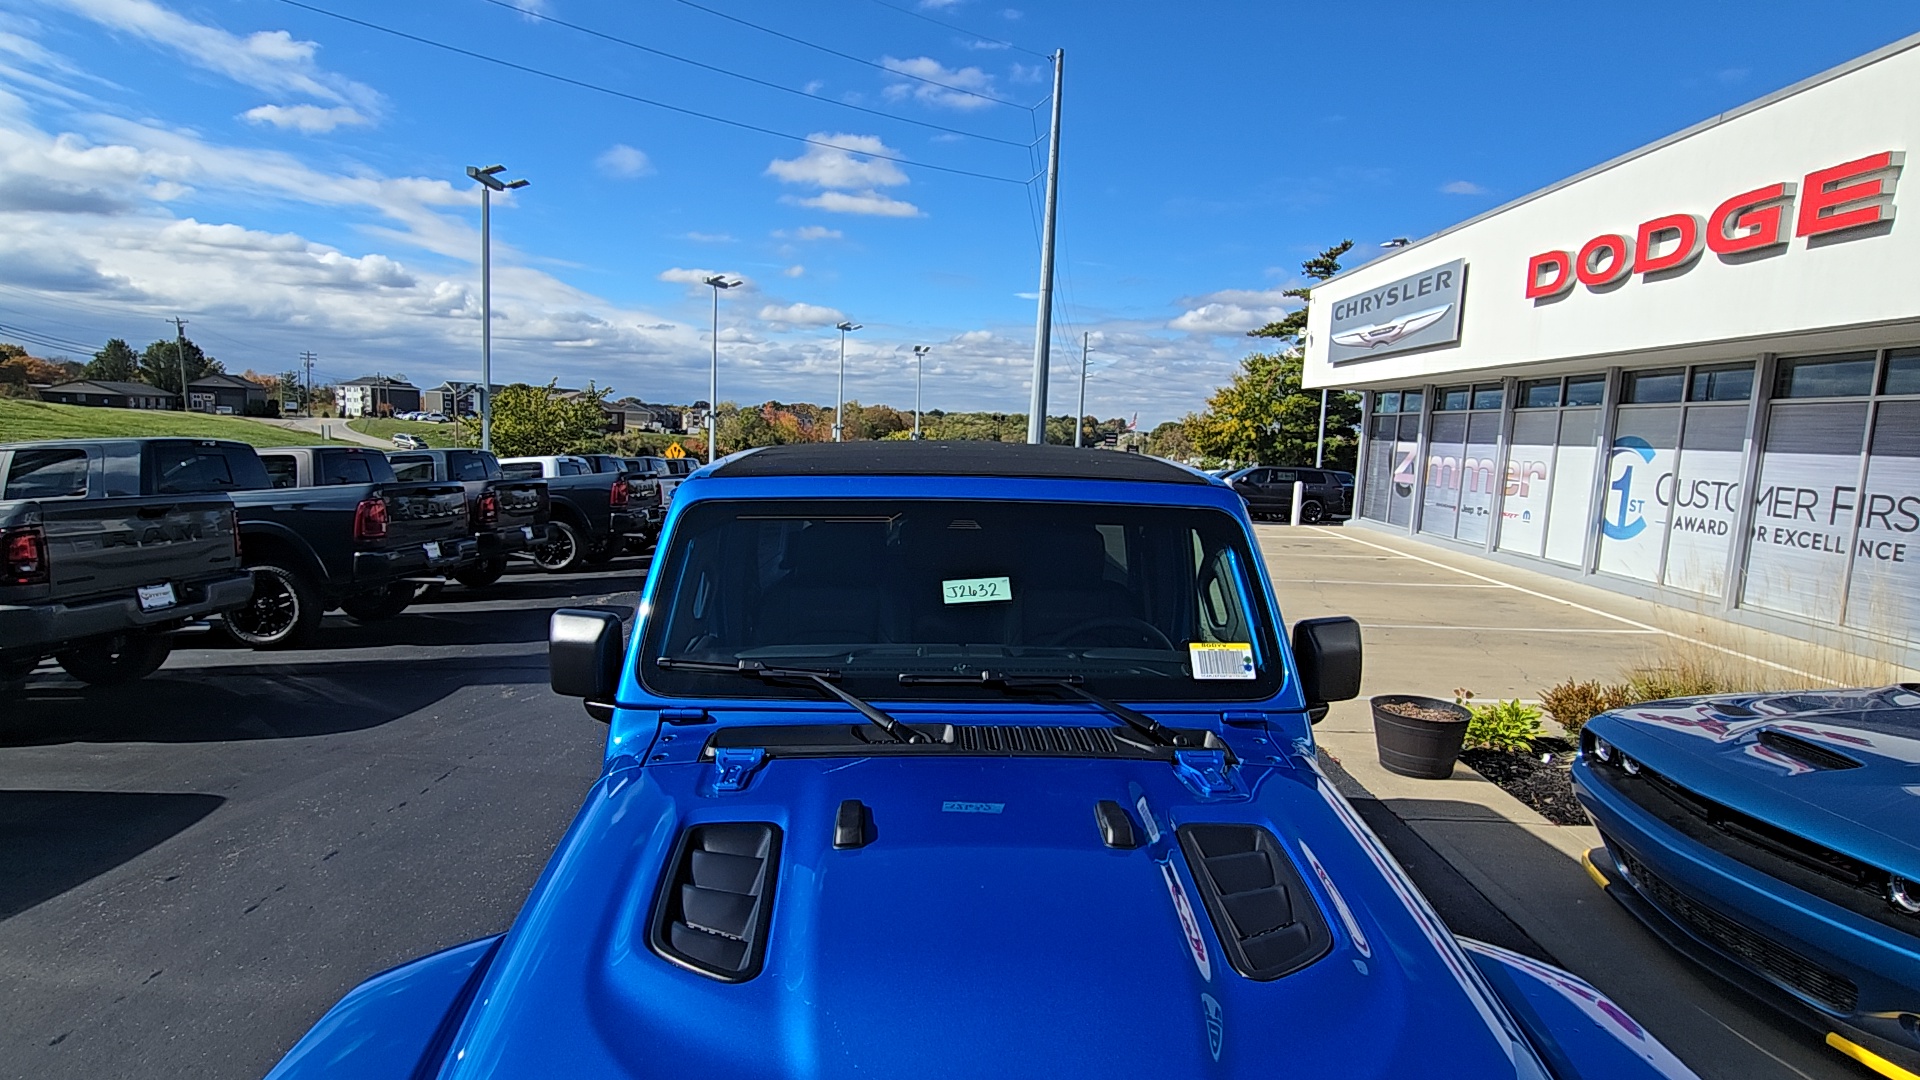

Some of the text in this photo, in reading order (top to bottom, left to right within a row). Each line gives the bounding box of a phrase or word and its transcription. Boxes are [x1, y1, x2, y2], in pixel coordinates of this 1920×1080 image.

[1526, 151, 1903, 299] DODGE
[1334, 270, 1453, 321] CHRYSLER
[1393, 441, 1547, 497] Zmmer
[1673, 515, 1728, 536] AWARD
[1774, 527, 1907, 563] EXCELLNCE
[945, 582, 1001, 599] J2632
